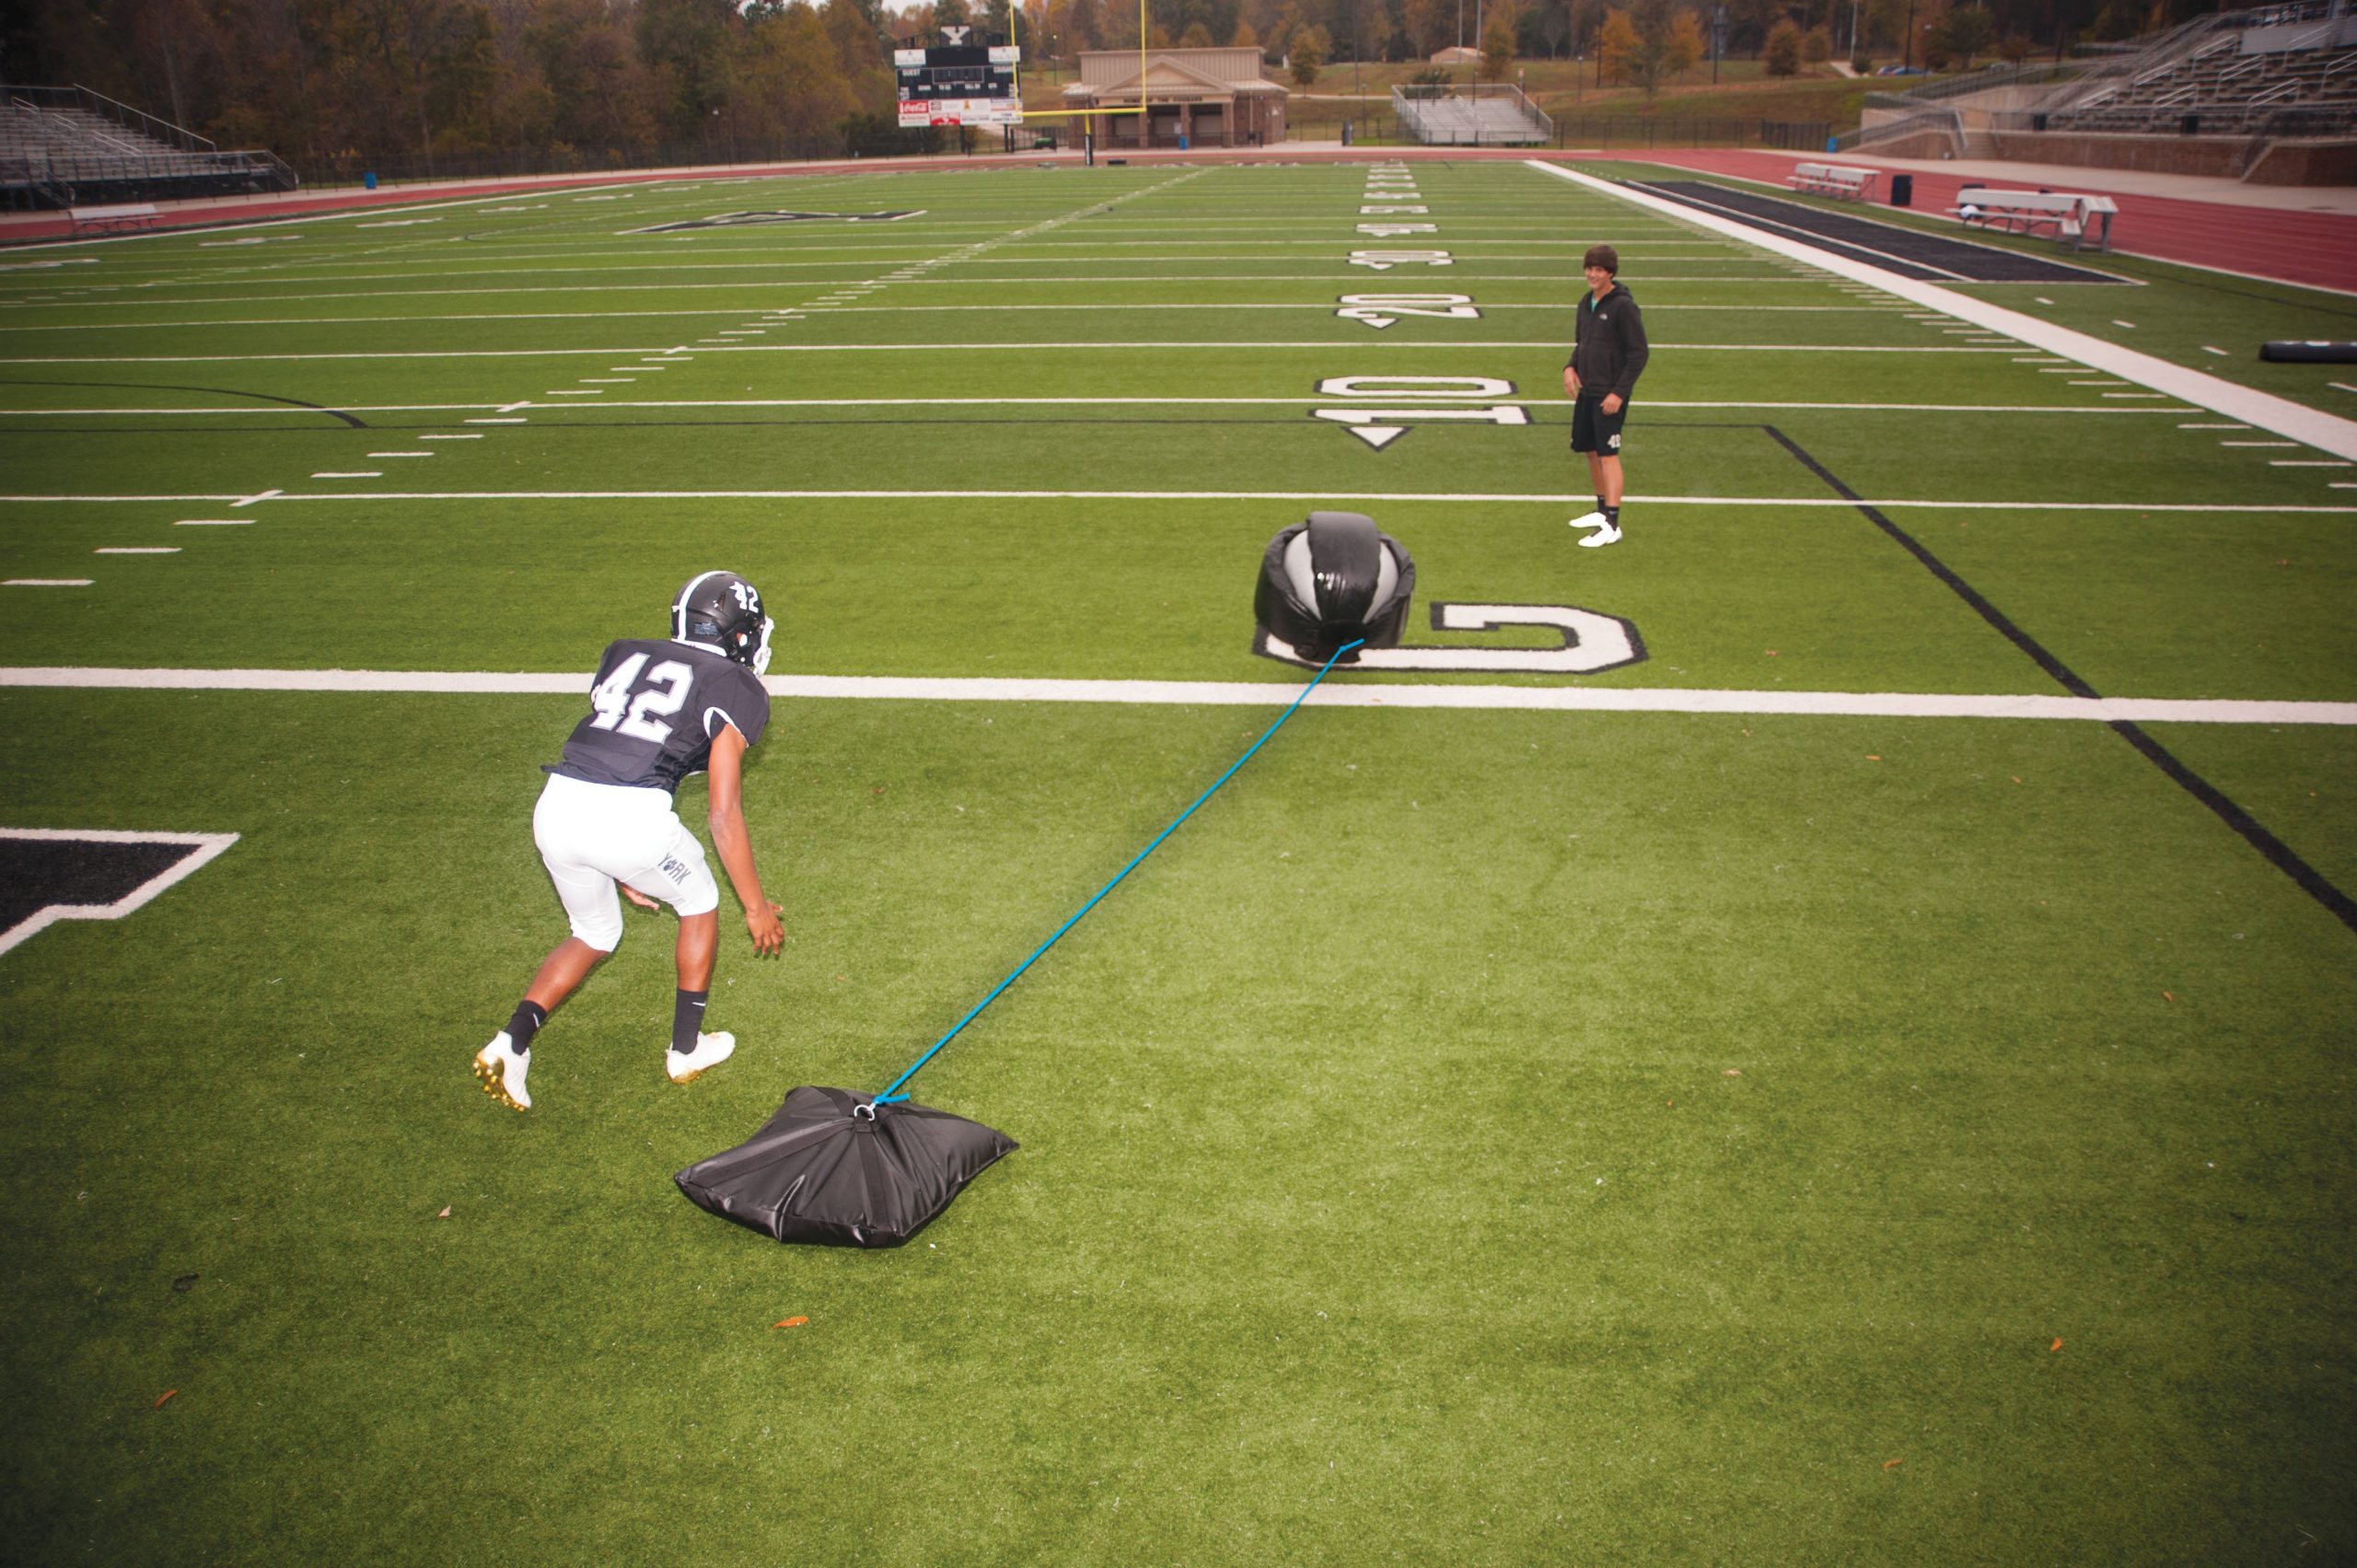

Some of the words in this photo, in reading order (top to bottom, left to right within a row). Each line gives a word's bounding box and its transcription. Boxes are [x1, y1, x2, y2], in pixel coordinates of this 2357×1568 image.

[940, 26, 970, 45] Y
[1335, 293, 1483, 319] 20
[1311, 375, 1531, 424] 10
[729, 581, 759, 613] 42
[589, 652, 693, 745] 42
